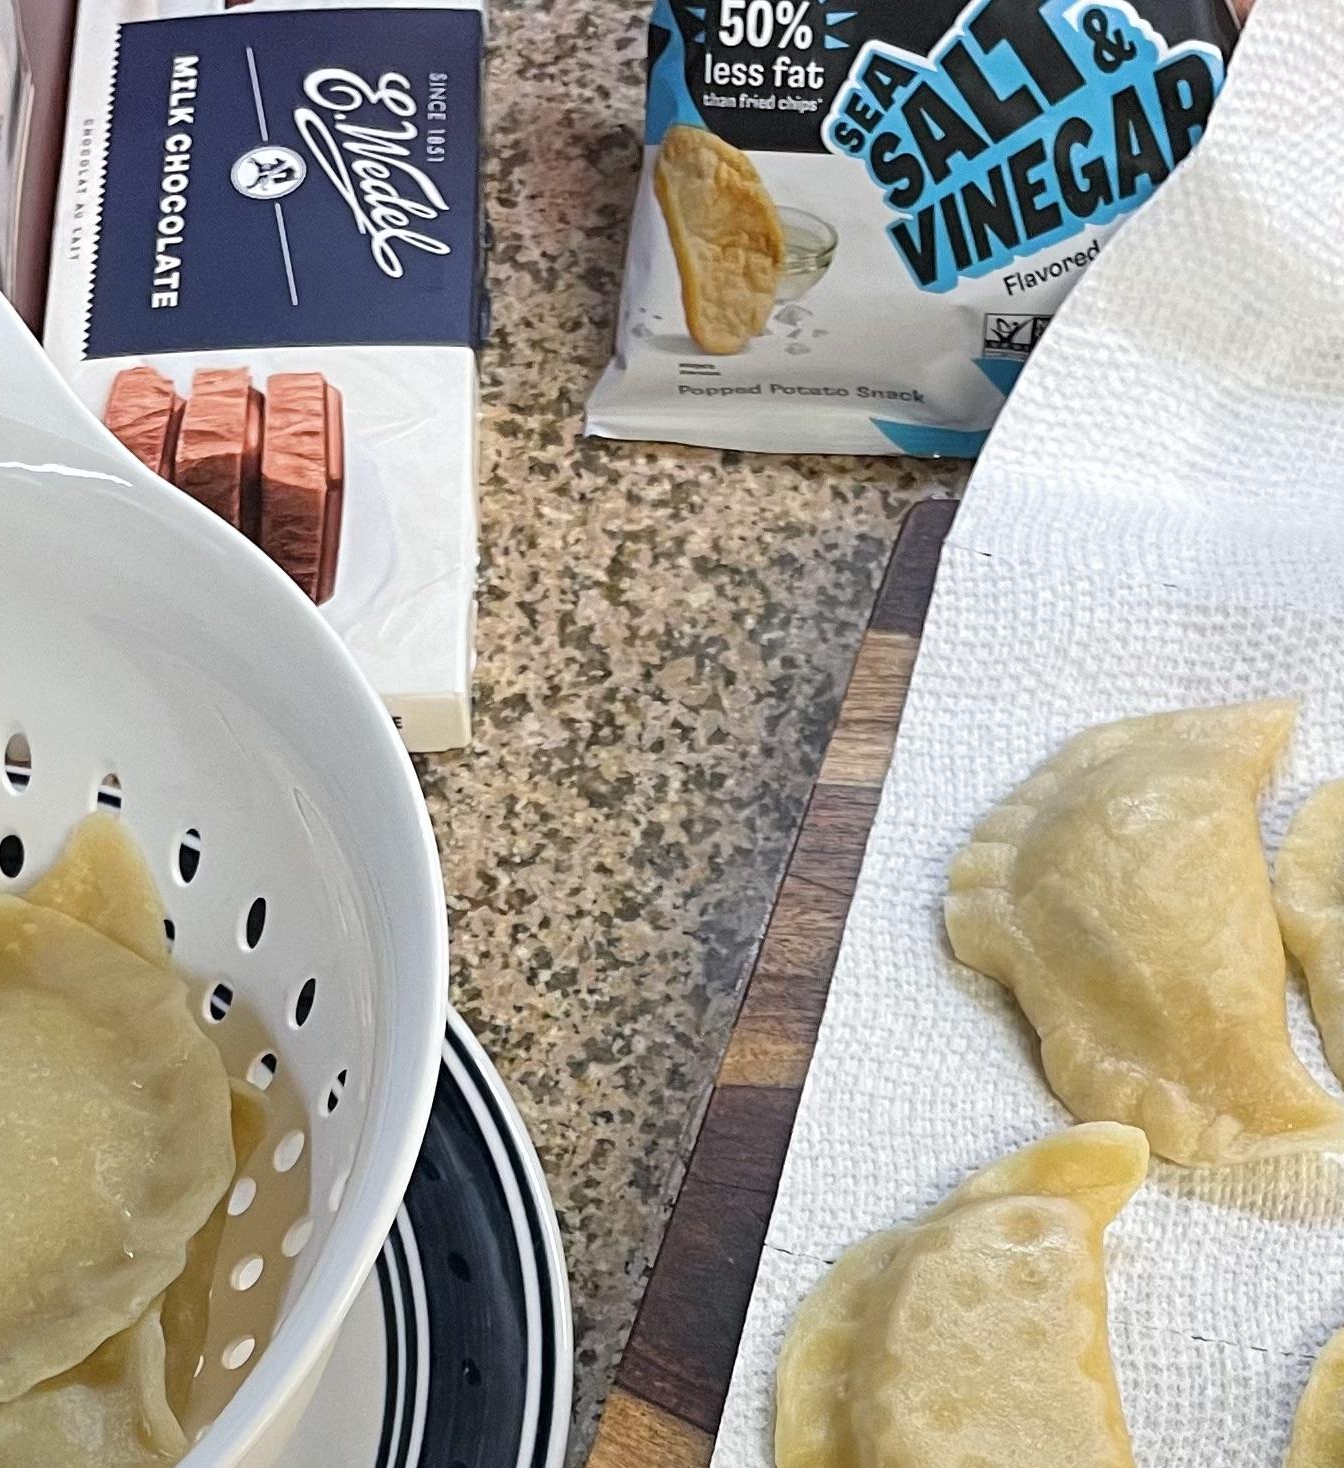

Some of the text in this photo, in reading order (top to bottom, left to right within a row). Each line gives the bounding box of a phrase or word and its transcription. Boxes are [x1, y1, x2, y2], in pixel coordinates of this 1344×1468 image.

[719, 0, 813, 50] 50%
[427, 72, 448, 120] SINCE
[704, 53, 824, 90] less fat
[703, 93, 737, 108] than
[739, 94, 776, 111] fried
[834, 54, 918, 153] SEA
[869, 0, 1136, 209] SALT &
[75, 118, 94, 194] CHOCOLAT
[151, 54, 199, 309] MILK CHOCOLATE
[892, 54, 1214, 286] VINEGAR
[73, 203, 83, 220] AU
[1003, 240, 1100, 296] Flavored
[678, 383, 926, 404] Popped Potato Snack
